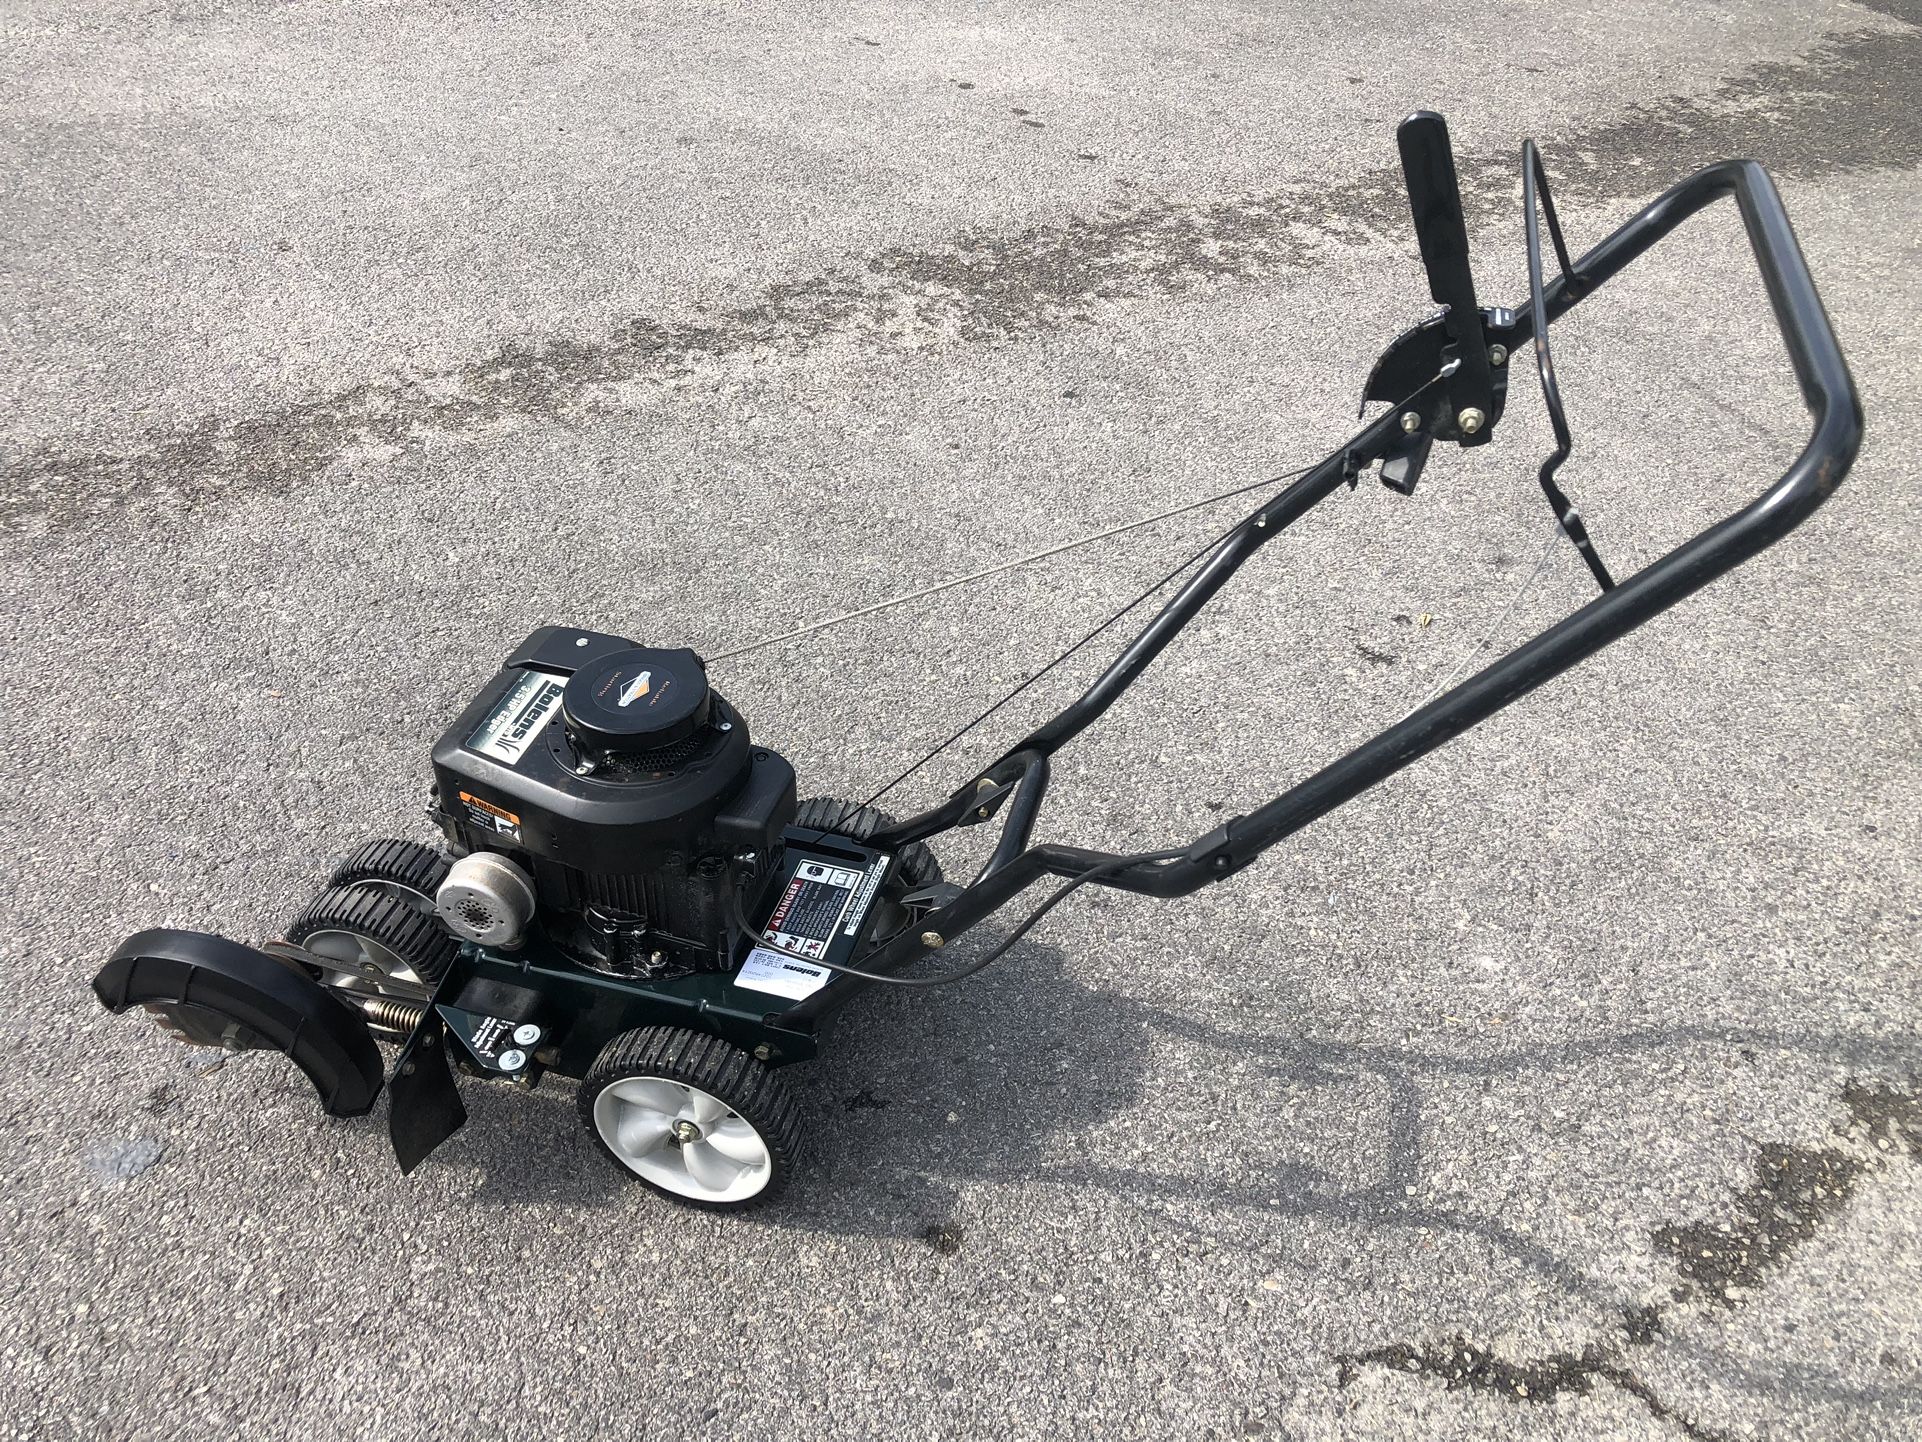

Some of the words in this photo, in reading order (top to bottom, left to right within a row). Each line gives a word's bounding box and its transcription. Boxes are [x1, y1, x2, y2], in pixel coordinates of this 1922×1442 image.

[487, 710, 512, 735] Edger
[511, 683, 565, 740] Bolens
[477, 800, 511, 821] WARNING
[779, 883, 800, 918] DANGER
[782, 964, 821, 977] Bolens
